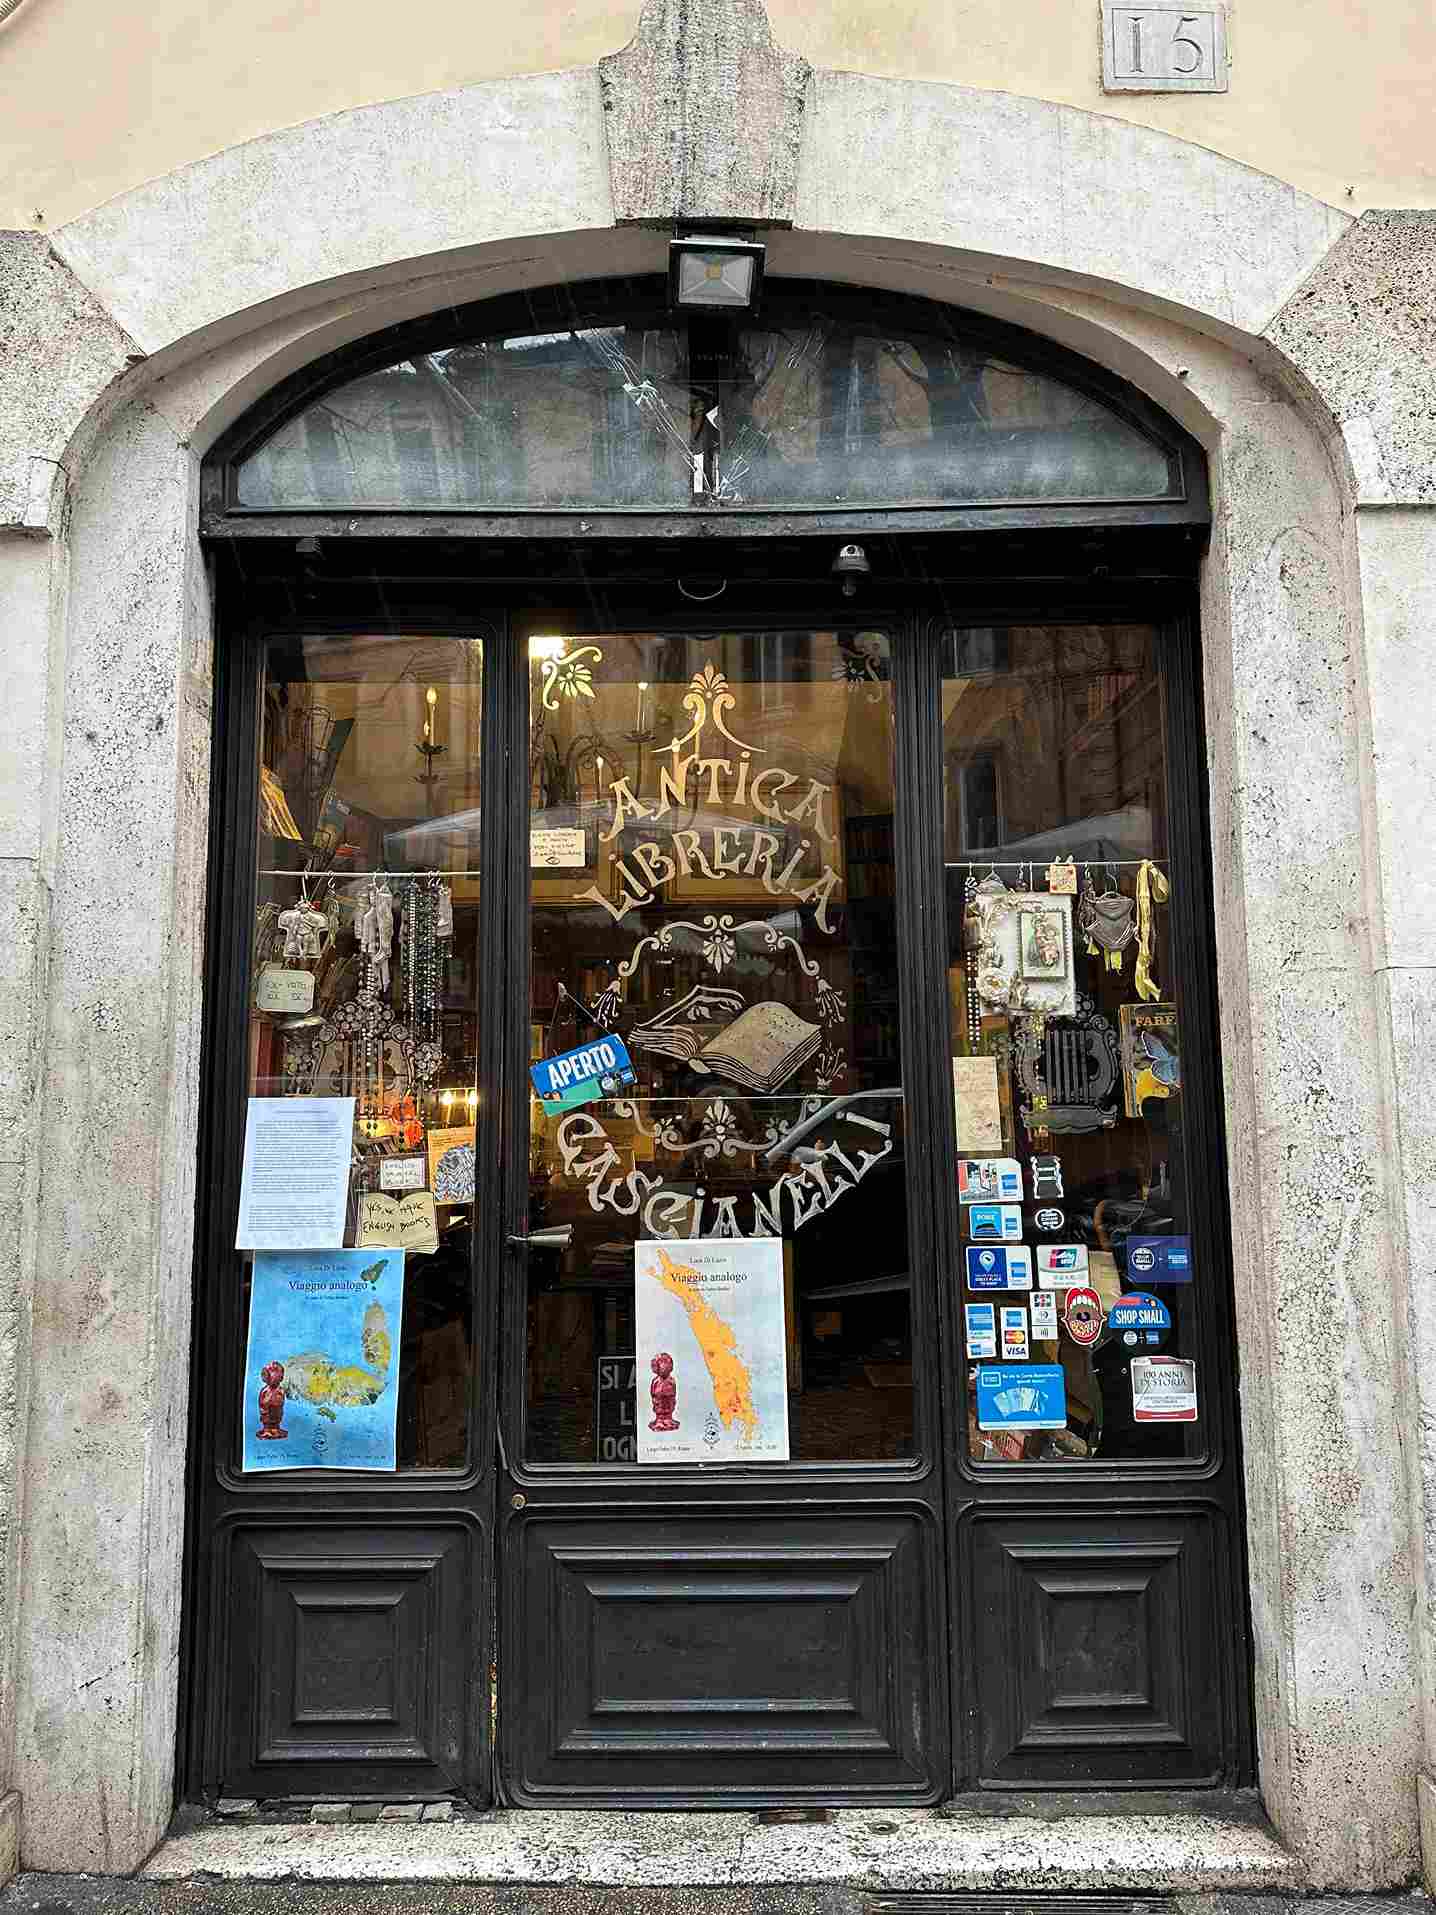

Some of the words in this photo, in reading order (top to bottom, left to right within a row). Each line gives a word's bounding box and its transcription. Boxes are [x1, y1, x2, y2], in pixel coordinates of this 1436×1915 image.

[1128, 16, 1204, 73] 15
[598, 750, 838, 842] ANTICA
[573, 827, 844, 934] LIBRERIA
[547, 1043, 616, 1090] APERTO
[557, 1110, 894, 1240] CASCIANELLI
[288, 1279, 327, 1292] Viaggio
[329, 1279, 368, 1292] analogo
[671, 1271, 708, 1284] Viaggio
[710, 1271, 748, 1284] analogo
[1115, 1309, 1138, 1325] SHOP
[1138, 1309, 1165, 1325] SMALL
[1006, 1346, 1026, 1356] VISA
[600, 1364, 620, 1390] SI
[1150, 1378, 1187, 1386] STORIA
[1158, 1369, 1184, 1378] ANNI
